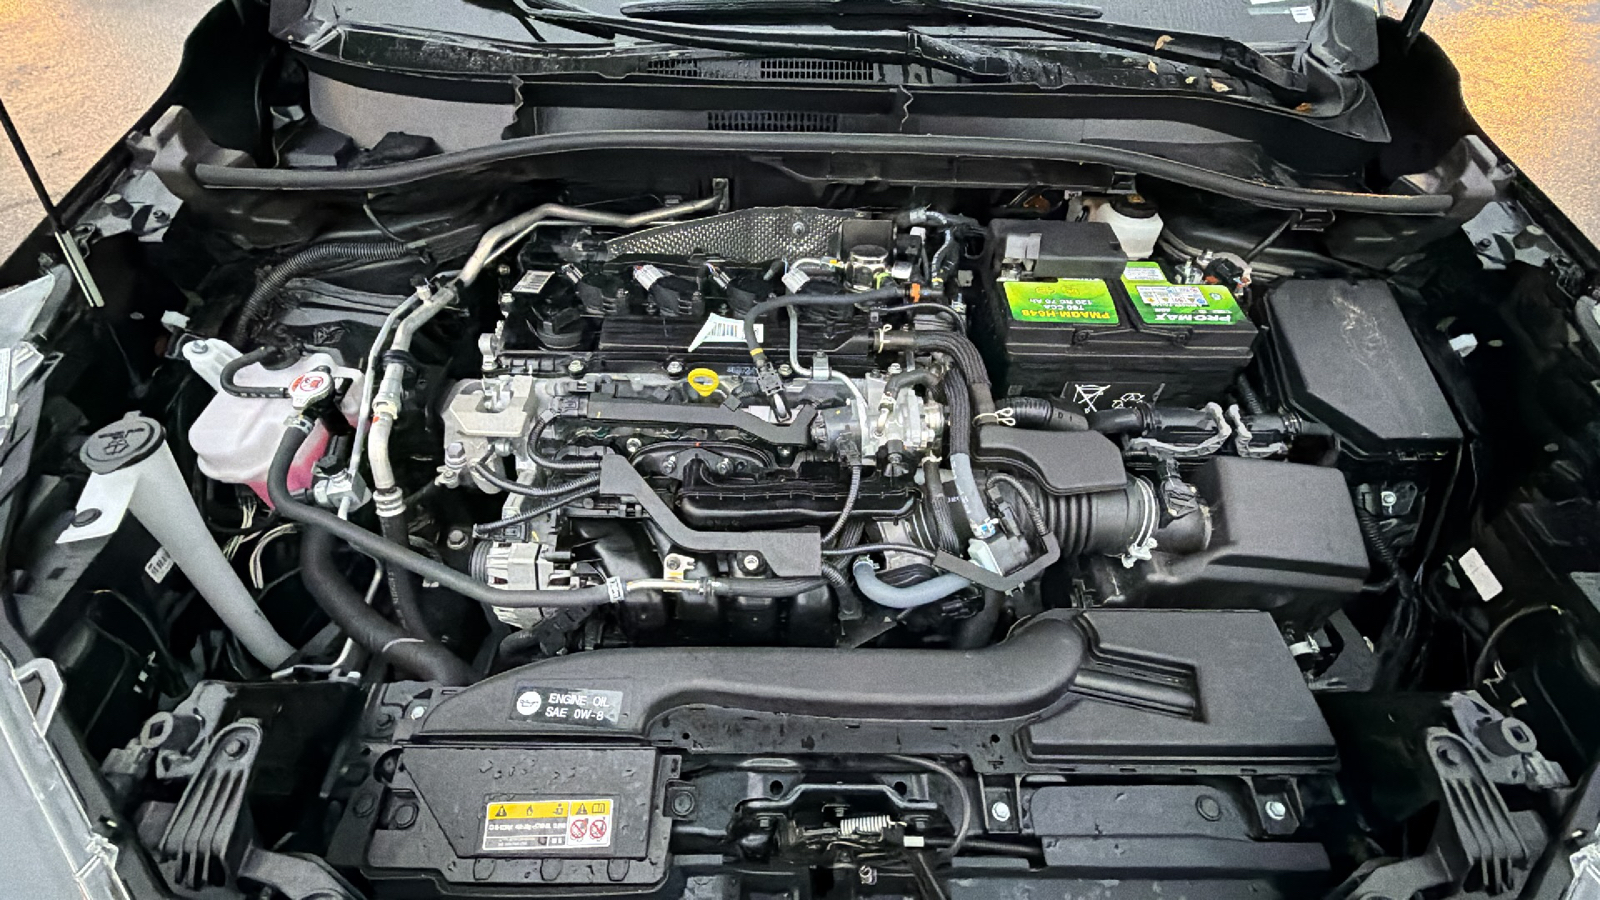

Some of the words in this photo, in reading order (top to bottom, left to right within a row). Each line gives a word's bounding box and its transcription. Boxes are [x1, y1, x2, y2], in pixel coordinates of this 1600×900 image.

[548, 693, 588, 706] ENGINE
[592, 696, 610, 707] OIL
[545, 706, 568, 718] SAE
[573, 709, 604, 720] 0W-8
